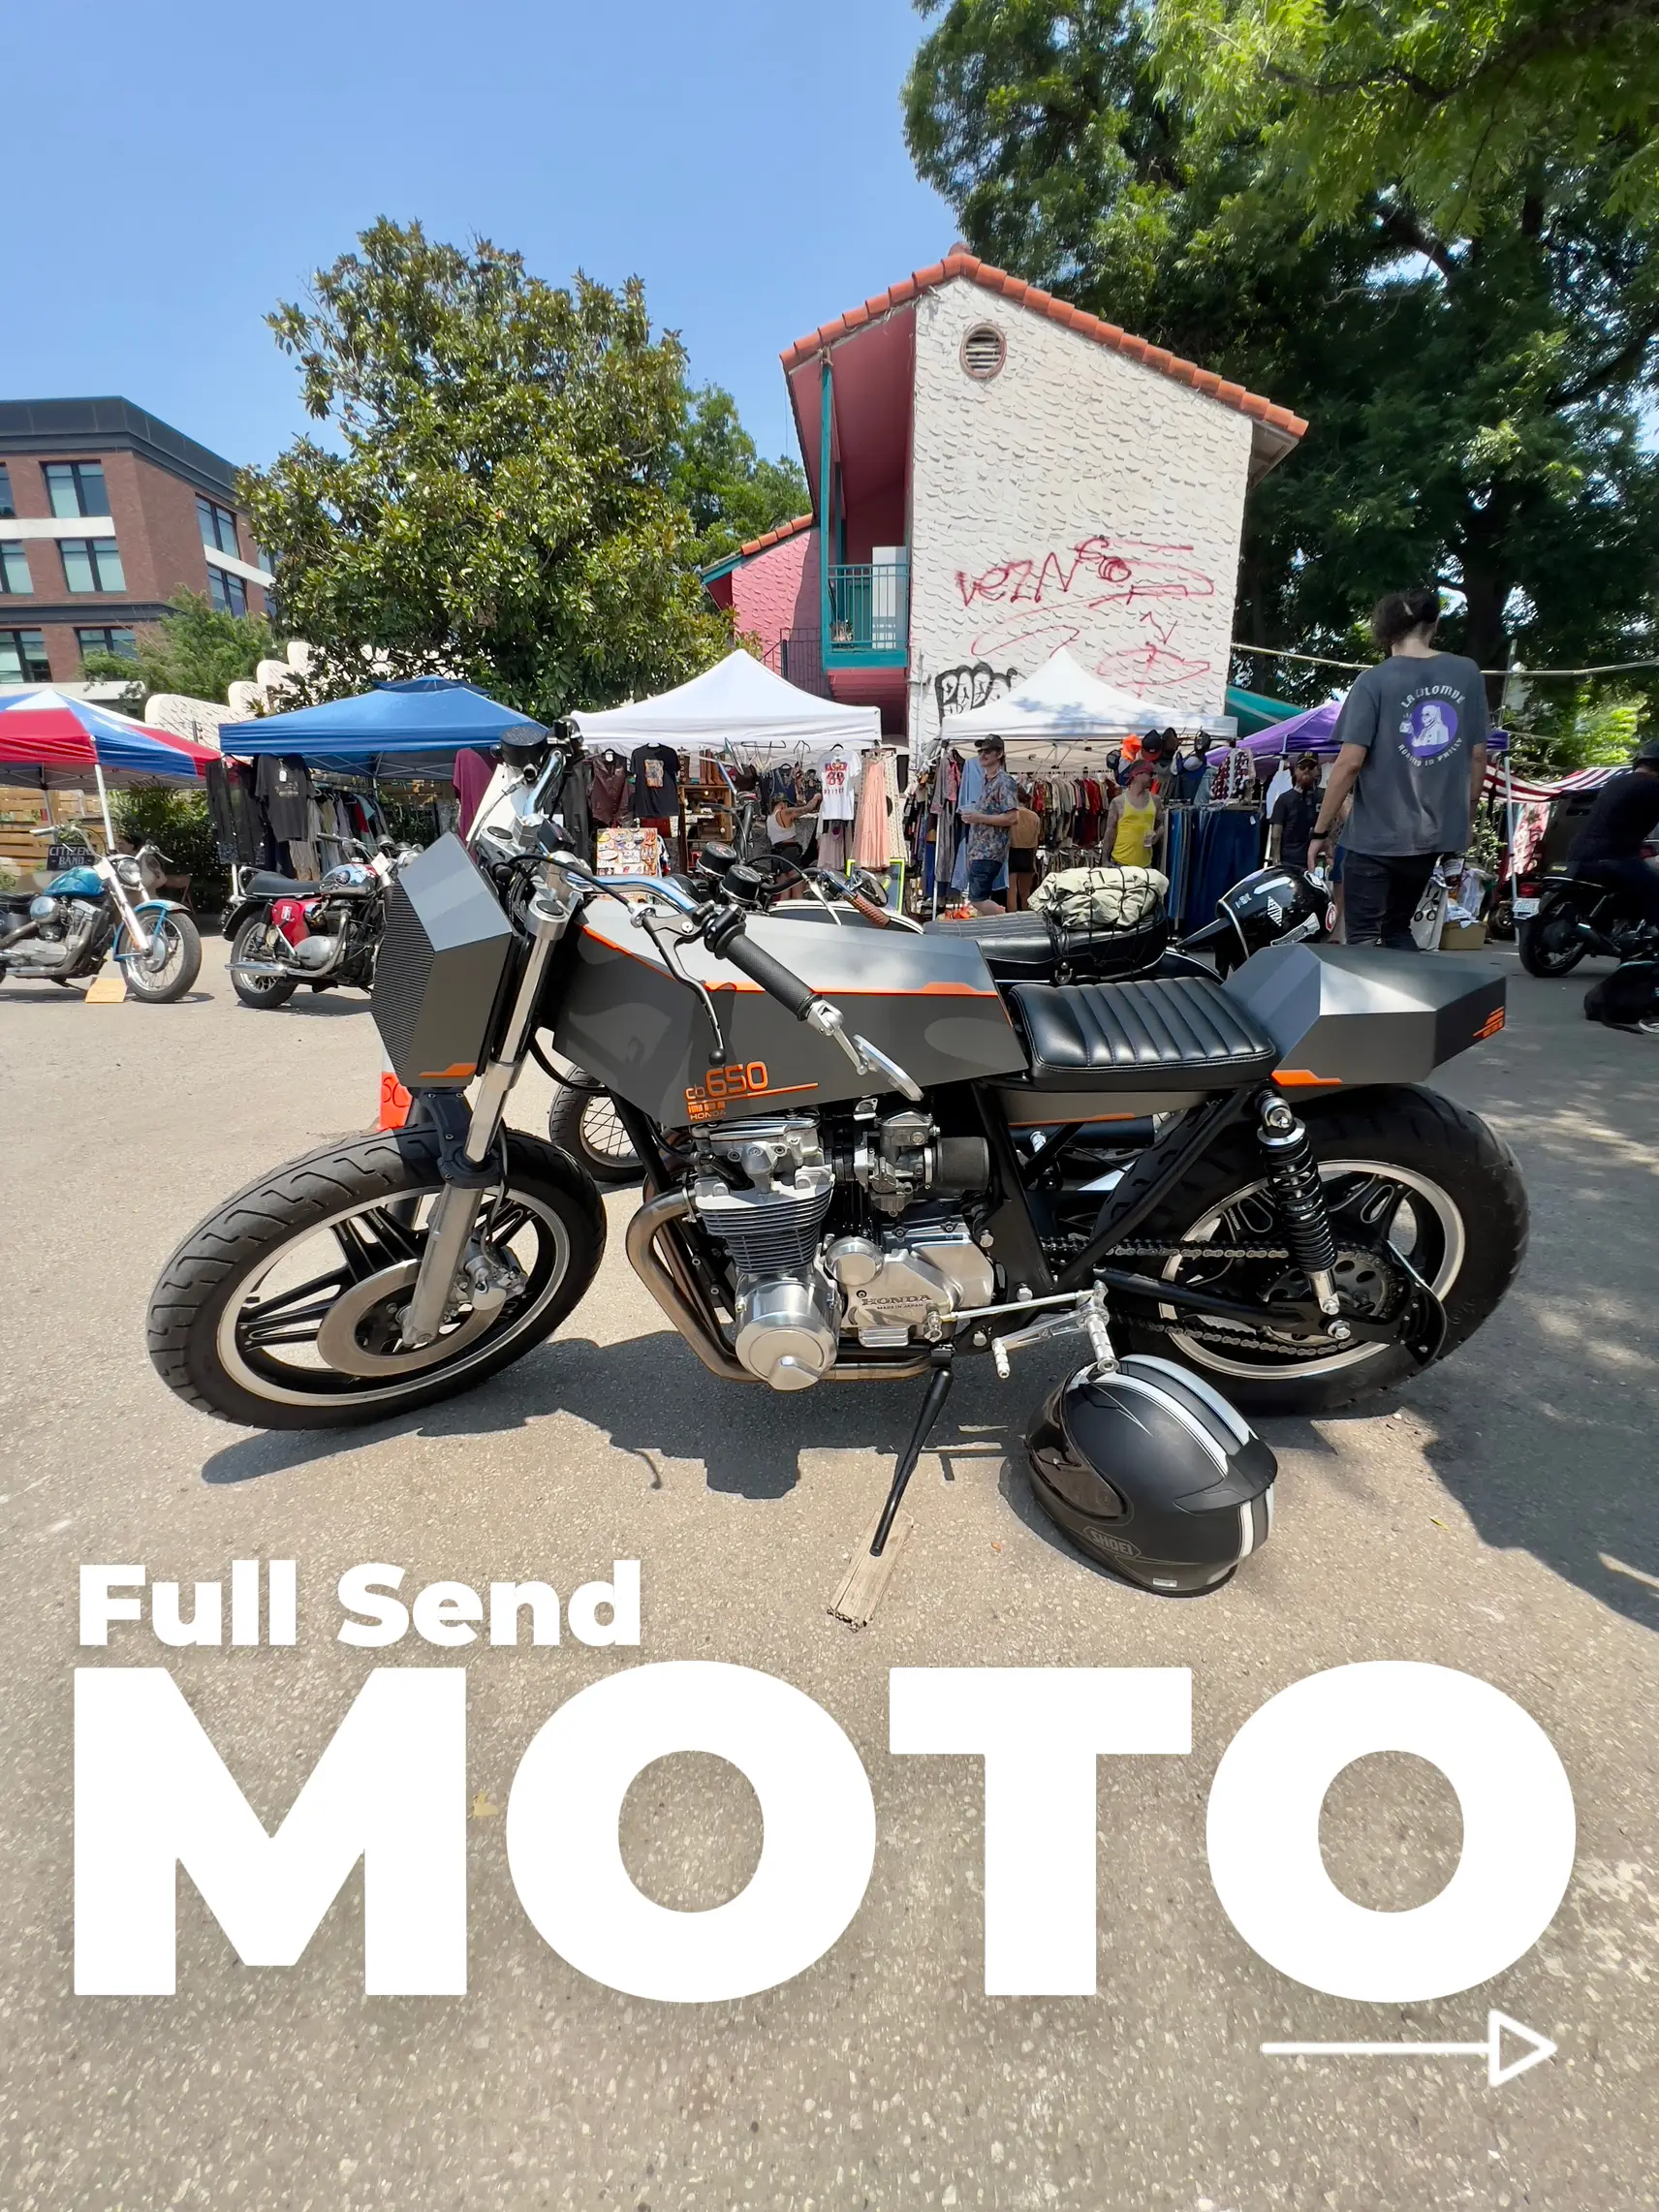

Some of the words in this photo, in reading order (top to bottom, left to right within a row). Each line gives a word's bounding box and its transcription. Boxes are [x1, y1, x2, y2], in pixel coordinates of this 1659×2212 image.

[1401, 694, 1416, 708] LA
[59, 856, 84, 865] BAND
[705, 1061, 768, 1097] 650
[689, 1108, 727, 1121] HONDA
[861, 1294, 932, 1305] HONDA
[1089, 1530, 1134, 1556] SHOEI
